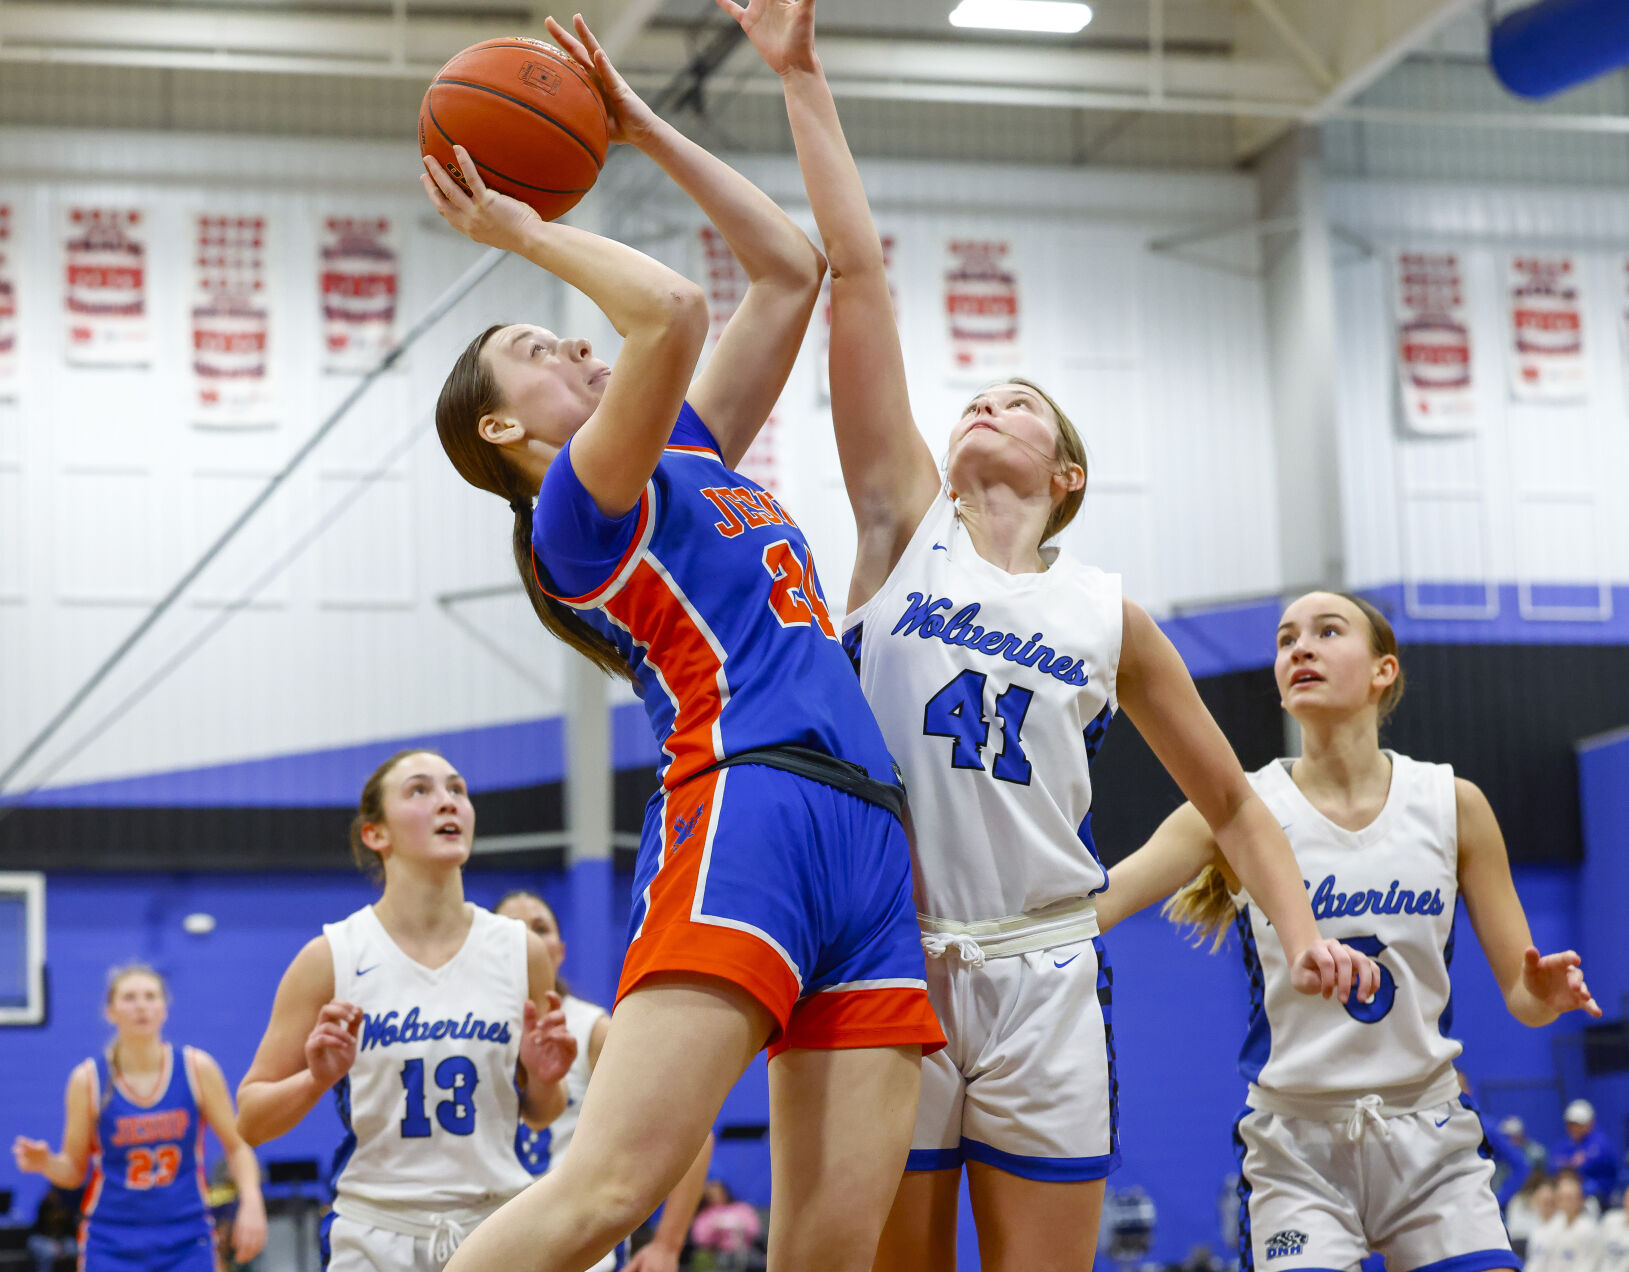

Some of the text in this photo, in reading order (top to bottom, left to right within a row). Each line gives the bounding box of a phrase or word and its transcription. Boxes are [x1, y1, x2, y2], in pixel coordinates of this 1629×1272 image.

[699, 486, 799, 540] JESU
[891, 591, 1089, 687] Wolverines
[922, 667, 1035, 786] 41
[1266, 874, 1445, 927] lverines
[360, 1006, 513, 1052] Wolverines
[400, 1055, 480, 1139] 13
[124, 1144, 182, 1190] 23
